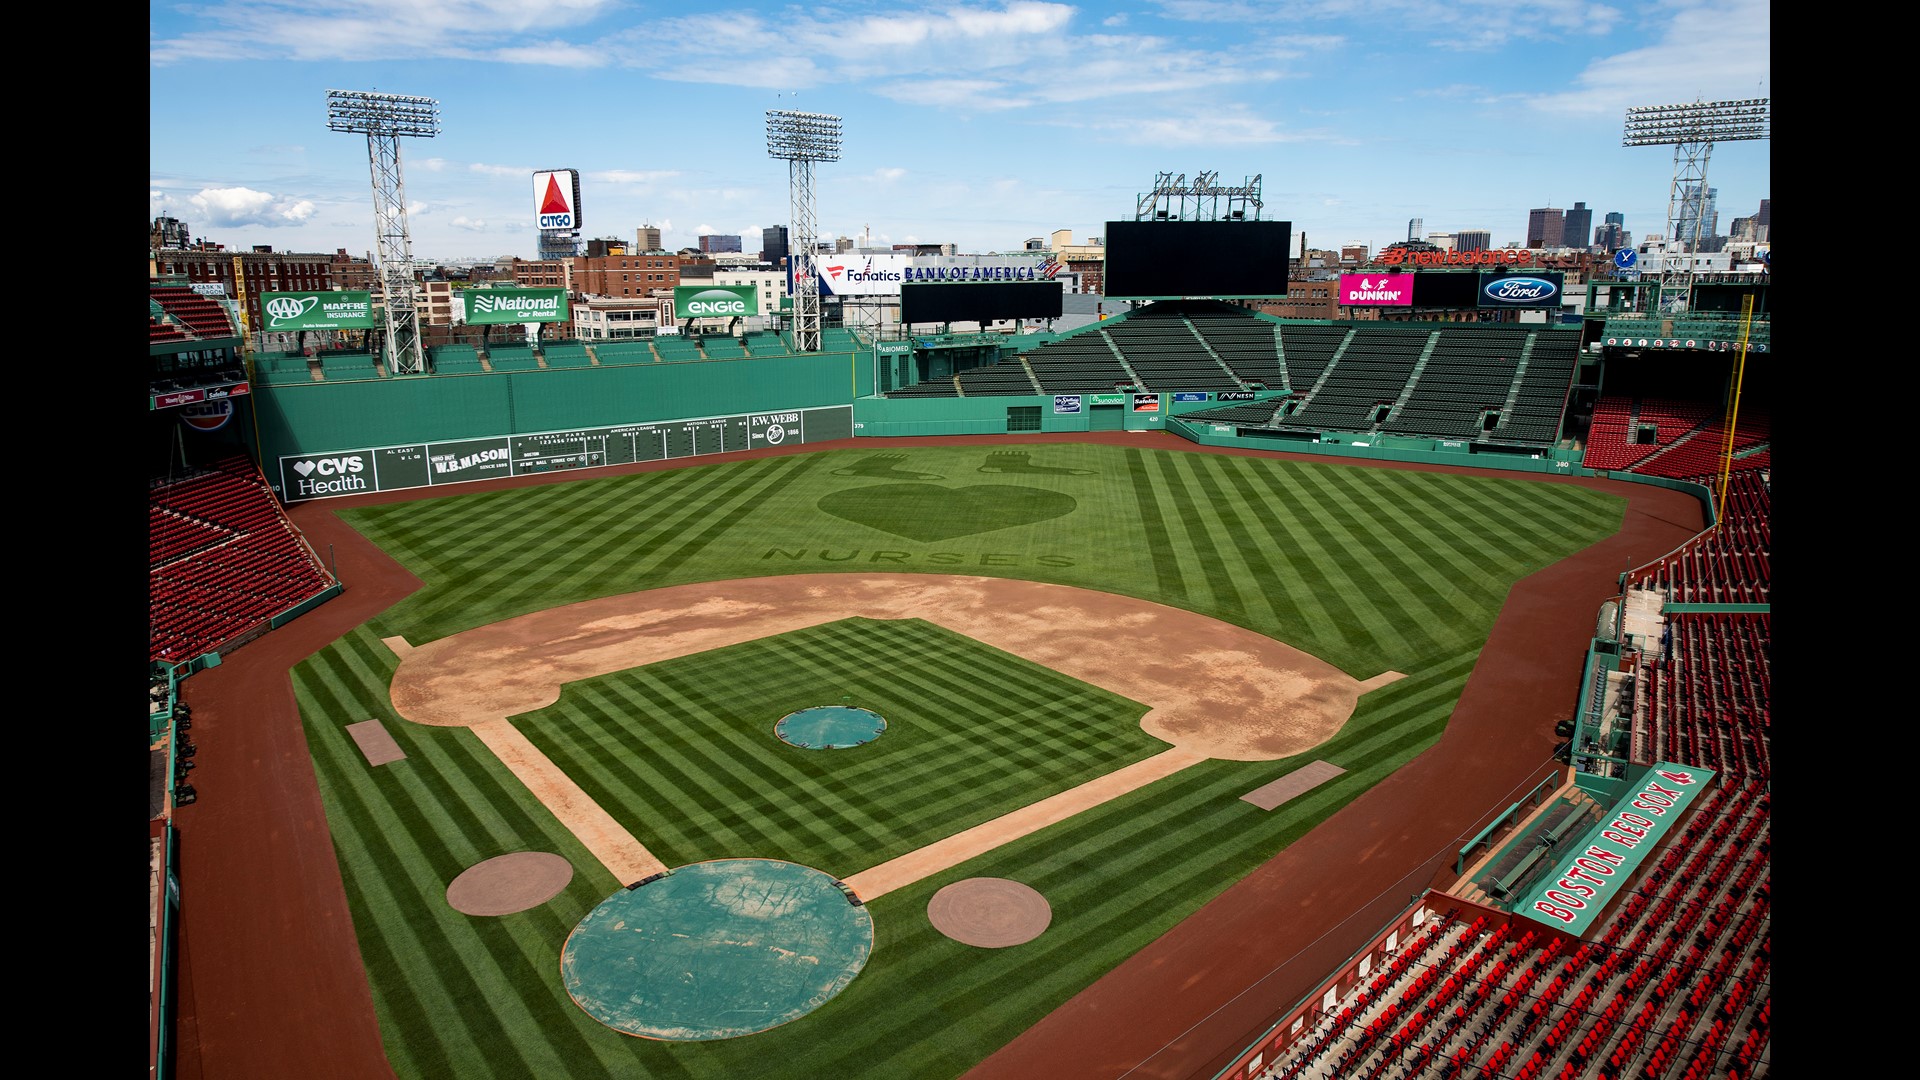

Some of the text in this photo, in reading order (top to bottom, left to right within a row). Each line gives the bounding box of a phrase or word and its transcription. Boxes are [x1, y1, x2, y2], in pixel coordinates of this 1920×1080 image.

[1138, 170, 1264, 216] John Hancock
[540, 214, 571, 228] CITGO
[1408, 247, 1531, 265] new balance
[847, 269, 901, 282] Fanatics
[904, 266, 1034, 279] BANK OF AMERICA
[1350, 290, 1402, 300] DUNKIN'
[1498, 279, 1542, 299] Ford
[323, 302, 368, 310] MAPFRE
[882, 345, 909, 353] ABIOMED
[185, 400, 228, 416] Gulf
[770, 413, 798, 424] WEBB
[316, 456, 364, 476] CVS
[298, 474, 366, 496] Health
[761, 547, 1076, 568] NURSES
[1533, 781, 1684, 923] BOSTON RED SOX
